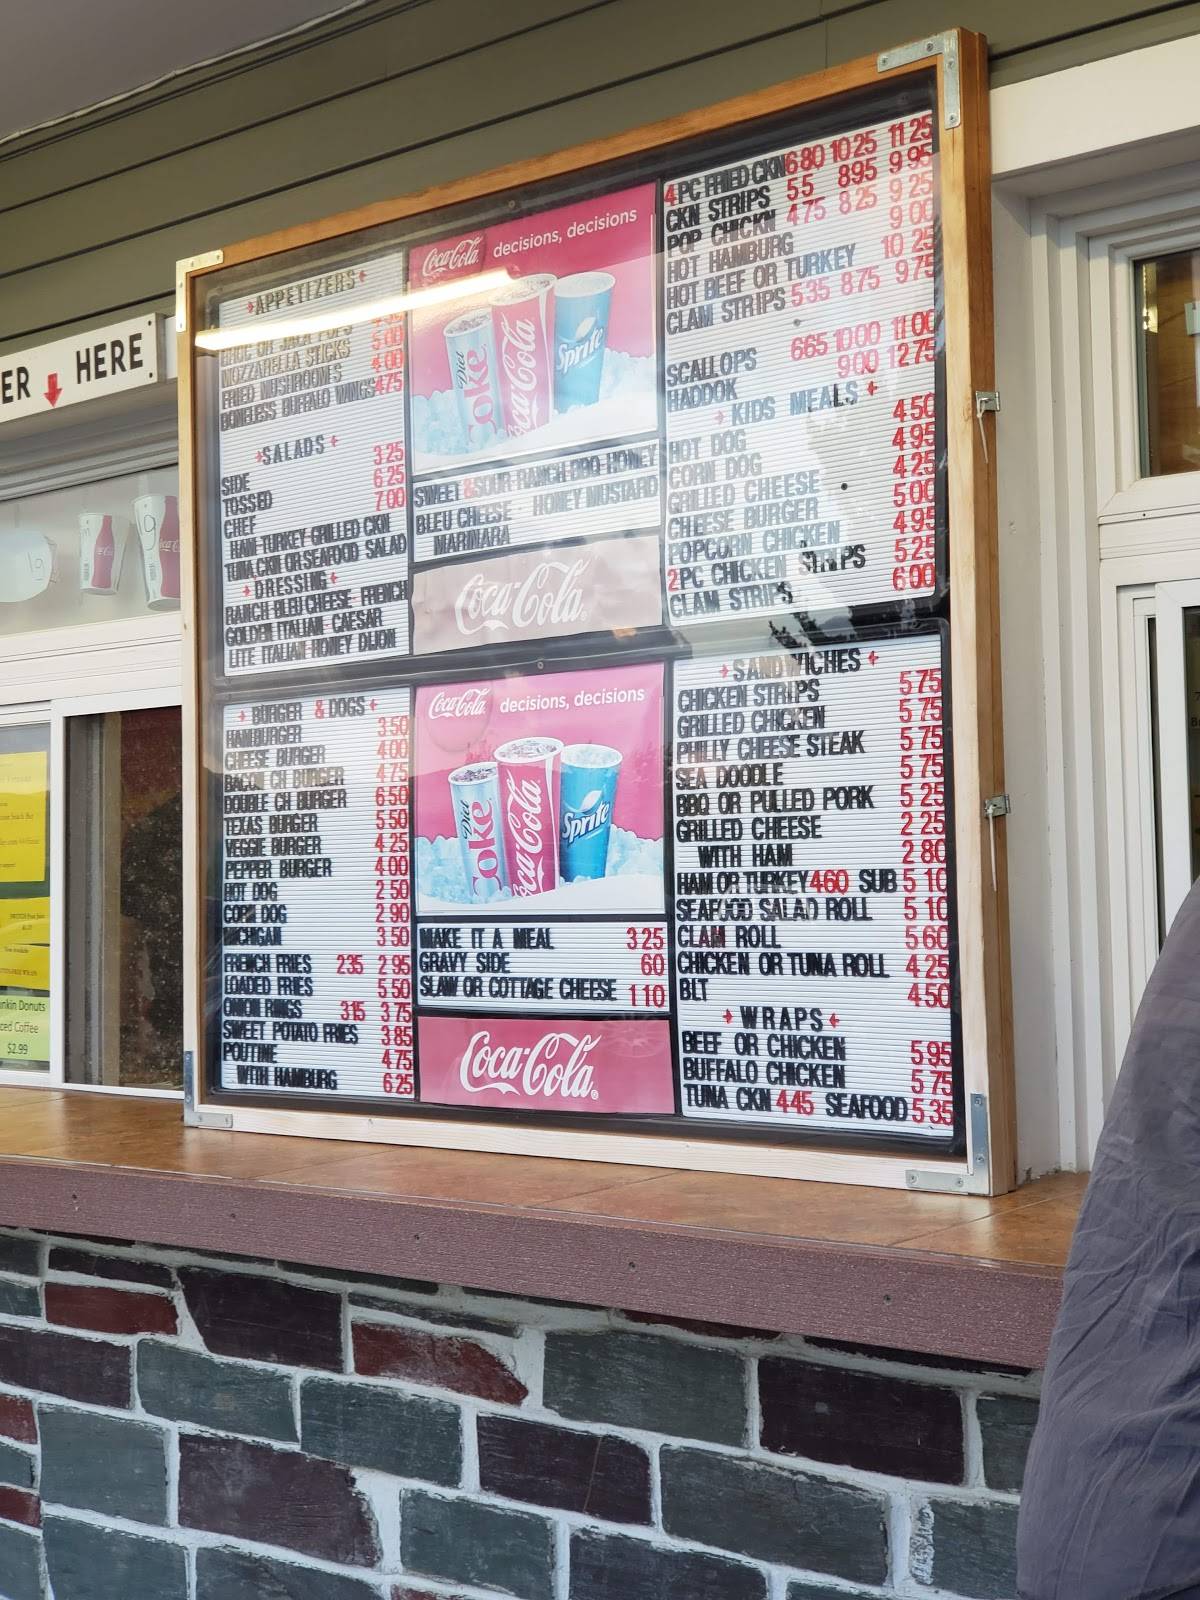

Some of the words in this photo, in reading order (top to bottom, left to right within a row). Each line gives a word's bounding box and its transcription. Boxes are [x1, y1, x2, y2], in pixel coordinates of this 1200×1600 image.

[705, 166, 749, 198] FRIED
[752, 155, 786, 184] CKN
[666, 203, 700, 232] CKN
[708, 185, 770, 222] STRIPS
[422, 235, 484, 277] Coca-Cola
[493, 228, 563, 258] decisions,
[567, 209, 637, 239] decisions
[667, 230, 701, 257] POP
[667, 256, 700, 284] HOT
[709, 232, 794, 273] HAMBURG
[667, 281, 699, 309] HOT
[704, 270, 746, 300] BEEF
[753, 262, 778, 288] OR
[787, 243, 855, 281] TURKEY
[255, 270, 355, 315] APPETIZERS
[666, 304, 714, 335] CLAM
[722, 287, 785, 323] STRIPS
[76, 332, 143, 384] HERE
[305, 338, 350, 368] STICKS
[559, 328, 603, 373] Sprite
[667, 348, 757, 387] SCALLOPS
[220, 400, 276, 432] BONELESS
[282, 388, 331, 418] BUFFALO
[335, 377, 375, 405] WINGS
[222, 387, 255, 410] FRIED
[732, 396, 776, 426] KIDS
[790, 381, 858, 416] MEALS
[262, 435, 324, 465] SALADS
[669, 437, 700, 463] HOT
[711, 429, 746, 456] DOG
[725, 453, 762, 480] DOG
[221, 473, 250, 496] SIDE
[414, 482, 460, 508] SWEET
[745, 470, 821, 501] CHEESE
[222, 490, 273, 517] TOSSED
[416, 510, 452, 535] BLEU
[457, 501, 512, 529] CHEESE
[669, 510, 734, 540] CHEESE
[744, 497, 818, 528] BURGER
[224, 515, 256, 539] CHEF
[363, 513, 390, 535] CKN
[302, 542, 359, 570] SEAFOOD
[365, 533, 407, 559] SALAD
[434, 524, 510, 556] MARINARA
[669, 533, 751, 565] POPCORN
[763, 520, 840, 552] CHICKEN
[255, 571, 327, 599] DRESSING
[711, 555, 786, 585] CHICKEN
[361, 580, 409, 606] FRENCH
[455, 560, 591, 635] Coca-Cola
[670, 590, 720, 617] CLAM
[729, 582, 793, 611] STRIPS
[226, 622, 273, 647] GOLDEN
[332, 608, 383, 633] CAESAR
[229, 646, 255, 668] LITE
[358, 628, 397, 652] DIJON
[733, 648, 861, 683] SANDWICHES
[252, 702, 302, 725] BURGER
[314, 700, 325, 719] &
[329, 696, 365, 718] DOGS
[429, 688, 490, 719] Coca-Cola
[500, 695, 570, 713] decisions,
[574, 688, 645, 708] decisions
[678, 685, 748, 713] CHICKEN
[753, 679, 820, 706] STRIPS
[226, 724, 302, 748] HAMBURGER
[677, 712, 744, 739] GRILLED
[751, 705, 825, 733] CHICKEN
[225, 750, 269, 770] CHEESE
[276, 745, 326, 767] BURGER
[677, 739, 729, 764] PHILLY
[738, 734, 800, 761] CHEESE
[806, 730, 865, 757] STEAK
[676, 767, 706, 790] SEA
[716, 762, 783, 788] DOODLE
[224, 794, 268, 814] DOUBLE
[274, 792, 291, 811] CH
[297, 789, 347, 810] BURGER
[676, 792, 710, 817] BBQ
[718, 792, 741, 814] OR
[751, 788, 815, 813] PULLED
[822, 785, 875, 810] PORK
[224, 816, 263, 836] TEXAS
[269, 813, 318, 834] BURGER
[561, 800, 610, 845] Sprite
[676, 818, 743, 842] GRILLED
[751, 815, 823, 840] CHEESE
[225, 838, 266, 857] VEGGIE
[271, 836, 321, 856] BURGER
[697, 846, 742, 868] WITH
[752, 844, 793, 867] HAM
[225, 860, 272, 879] PEPPER
[280, 858, 332, 878] BURGER
[676, 872, 713, 895] HAM
[717, 872, 739, 894] OR
[743, 870, 808, 894] TURKEY
[809, 869, 849, 895] 460
[858, 869, 898, 894] SUB
[224, 882, 247, 901] HOT
[252, 882, 278, 901] DOG
[261, 904, 287, 923] DOG
[759, 897, 819, 922] SALAD
[825, 897, 873, 921] ROLL
[419, 927, 461, 949] MAKE
[471, 928, 485, 949] IT
[493, 928, 503, 949] A
[513, 928, 554, 950] MEAL
[677, 925, 726, 948] CLAM
[735, 925, 781, 948] ROLL
[224, 954, 270, 973] FRENCH
[276, 954, 312, 974] FRIES
[419, 952, 468, 973] GRAVY
[476, 952, 510, 973] SIDE
[640, 953, 665, 976] 60
[677, 951, 750, 975] CHICKEN
[758, 952, 783, 976] OR
[788, 952, 837, 977] TUNA
[843, 953, 890, 978] ROLL
[224, 976, 271, 995] LOADED
[278, 976, 313, 996] FRIES
[420, 976, 457, 997] SLAW
[463, 976, 483, 997] OR
[488, 977, 554, 999] COTTAGE
[559, 978, 617, 1001] CHEESE
[679, 978, 708, 1001] BLT
[223, 1020, 266, 1040] SWEET
[273, 1021, 318, 1042] POTATO
[323, 1023, 358, 1044] FRIES
[740, 1006, 823, 1032] WRAPS
[223, 1042, 277, 1063] POUTINE
[682, 1031, 722, 1054] BEEF
[734, 1033, 759, 1056] OR
[767, 1033, 846, 1061] CHICKEN
[237, 1065, 268, 1086] WITH
[274, 1067, 338, 1090] HAMBURG
[460, 1030, 601, 1099] Coca-Cola
[683, 1057, 758, 1084] BUFFALO
[766, 1061, 846, 1089] CHICKEN
[683, 1084, 728, 1109] TUNA
[736, 1087, 772, 1111] CKN
[776, 1089, 815, 1115] 445
[825, 1093, 908, 1122] SEAFOOD
